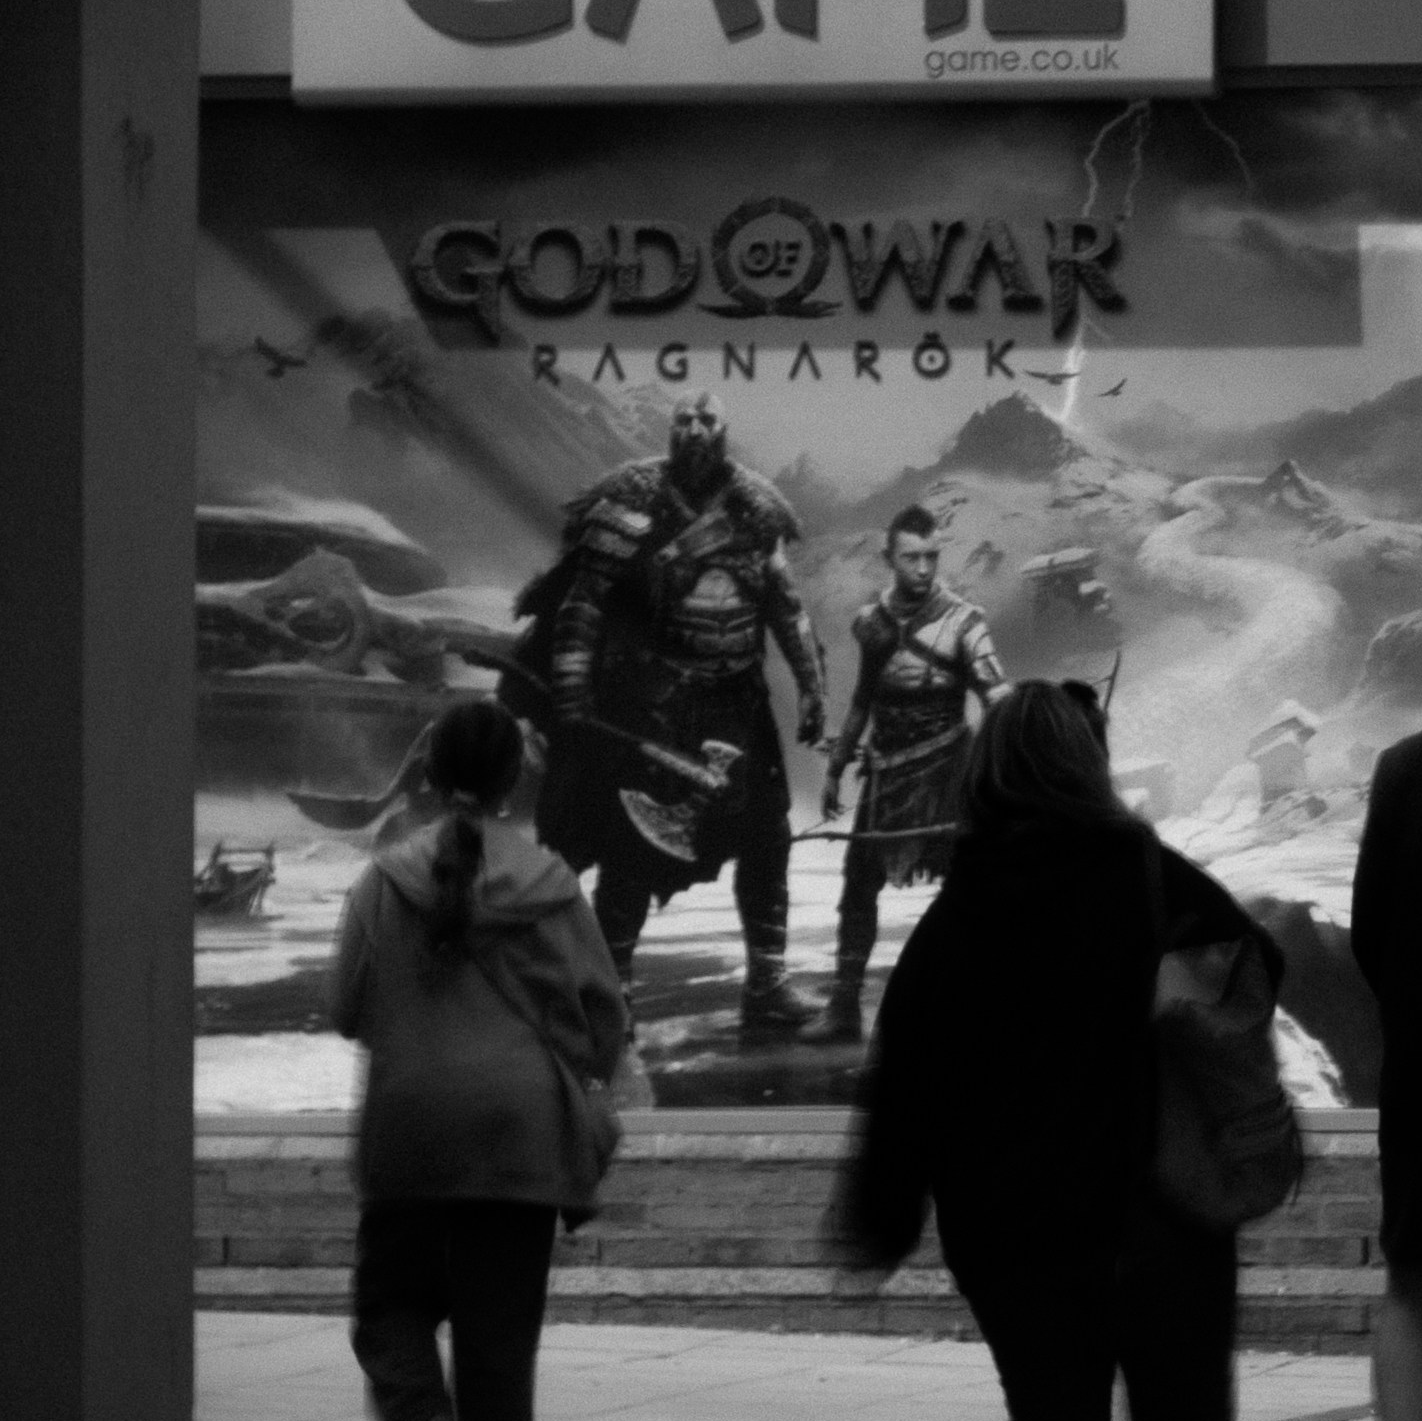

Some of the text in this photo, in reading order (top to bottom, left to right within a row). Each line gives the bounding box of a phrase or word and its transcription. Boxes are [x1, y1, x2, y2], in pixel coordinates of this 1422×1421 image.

[924, 43, 1120, 79] game.co.uk
[409, 216, 1128, 346] GOD OF WAR
